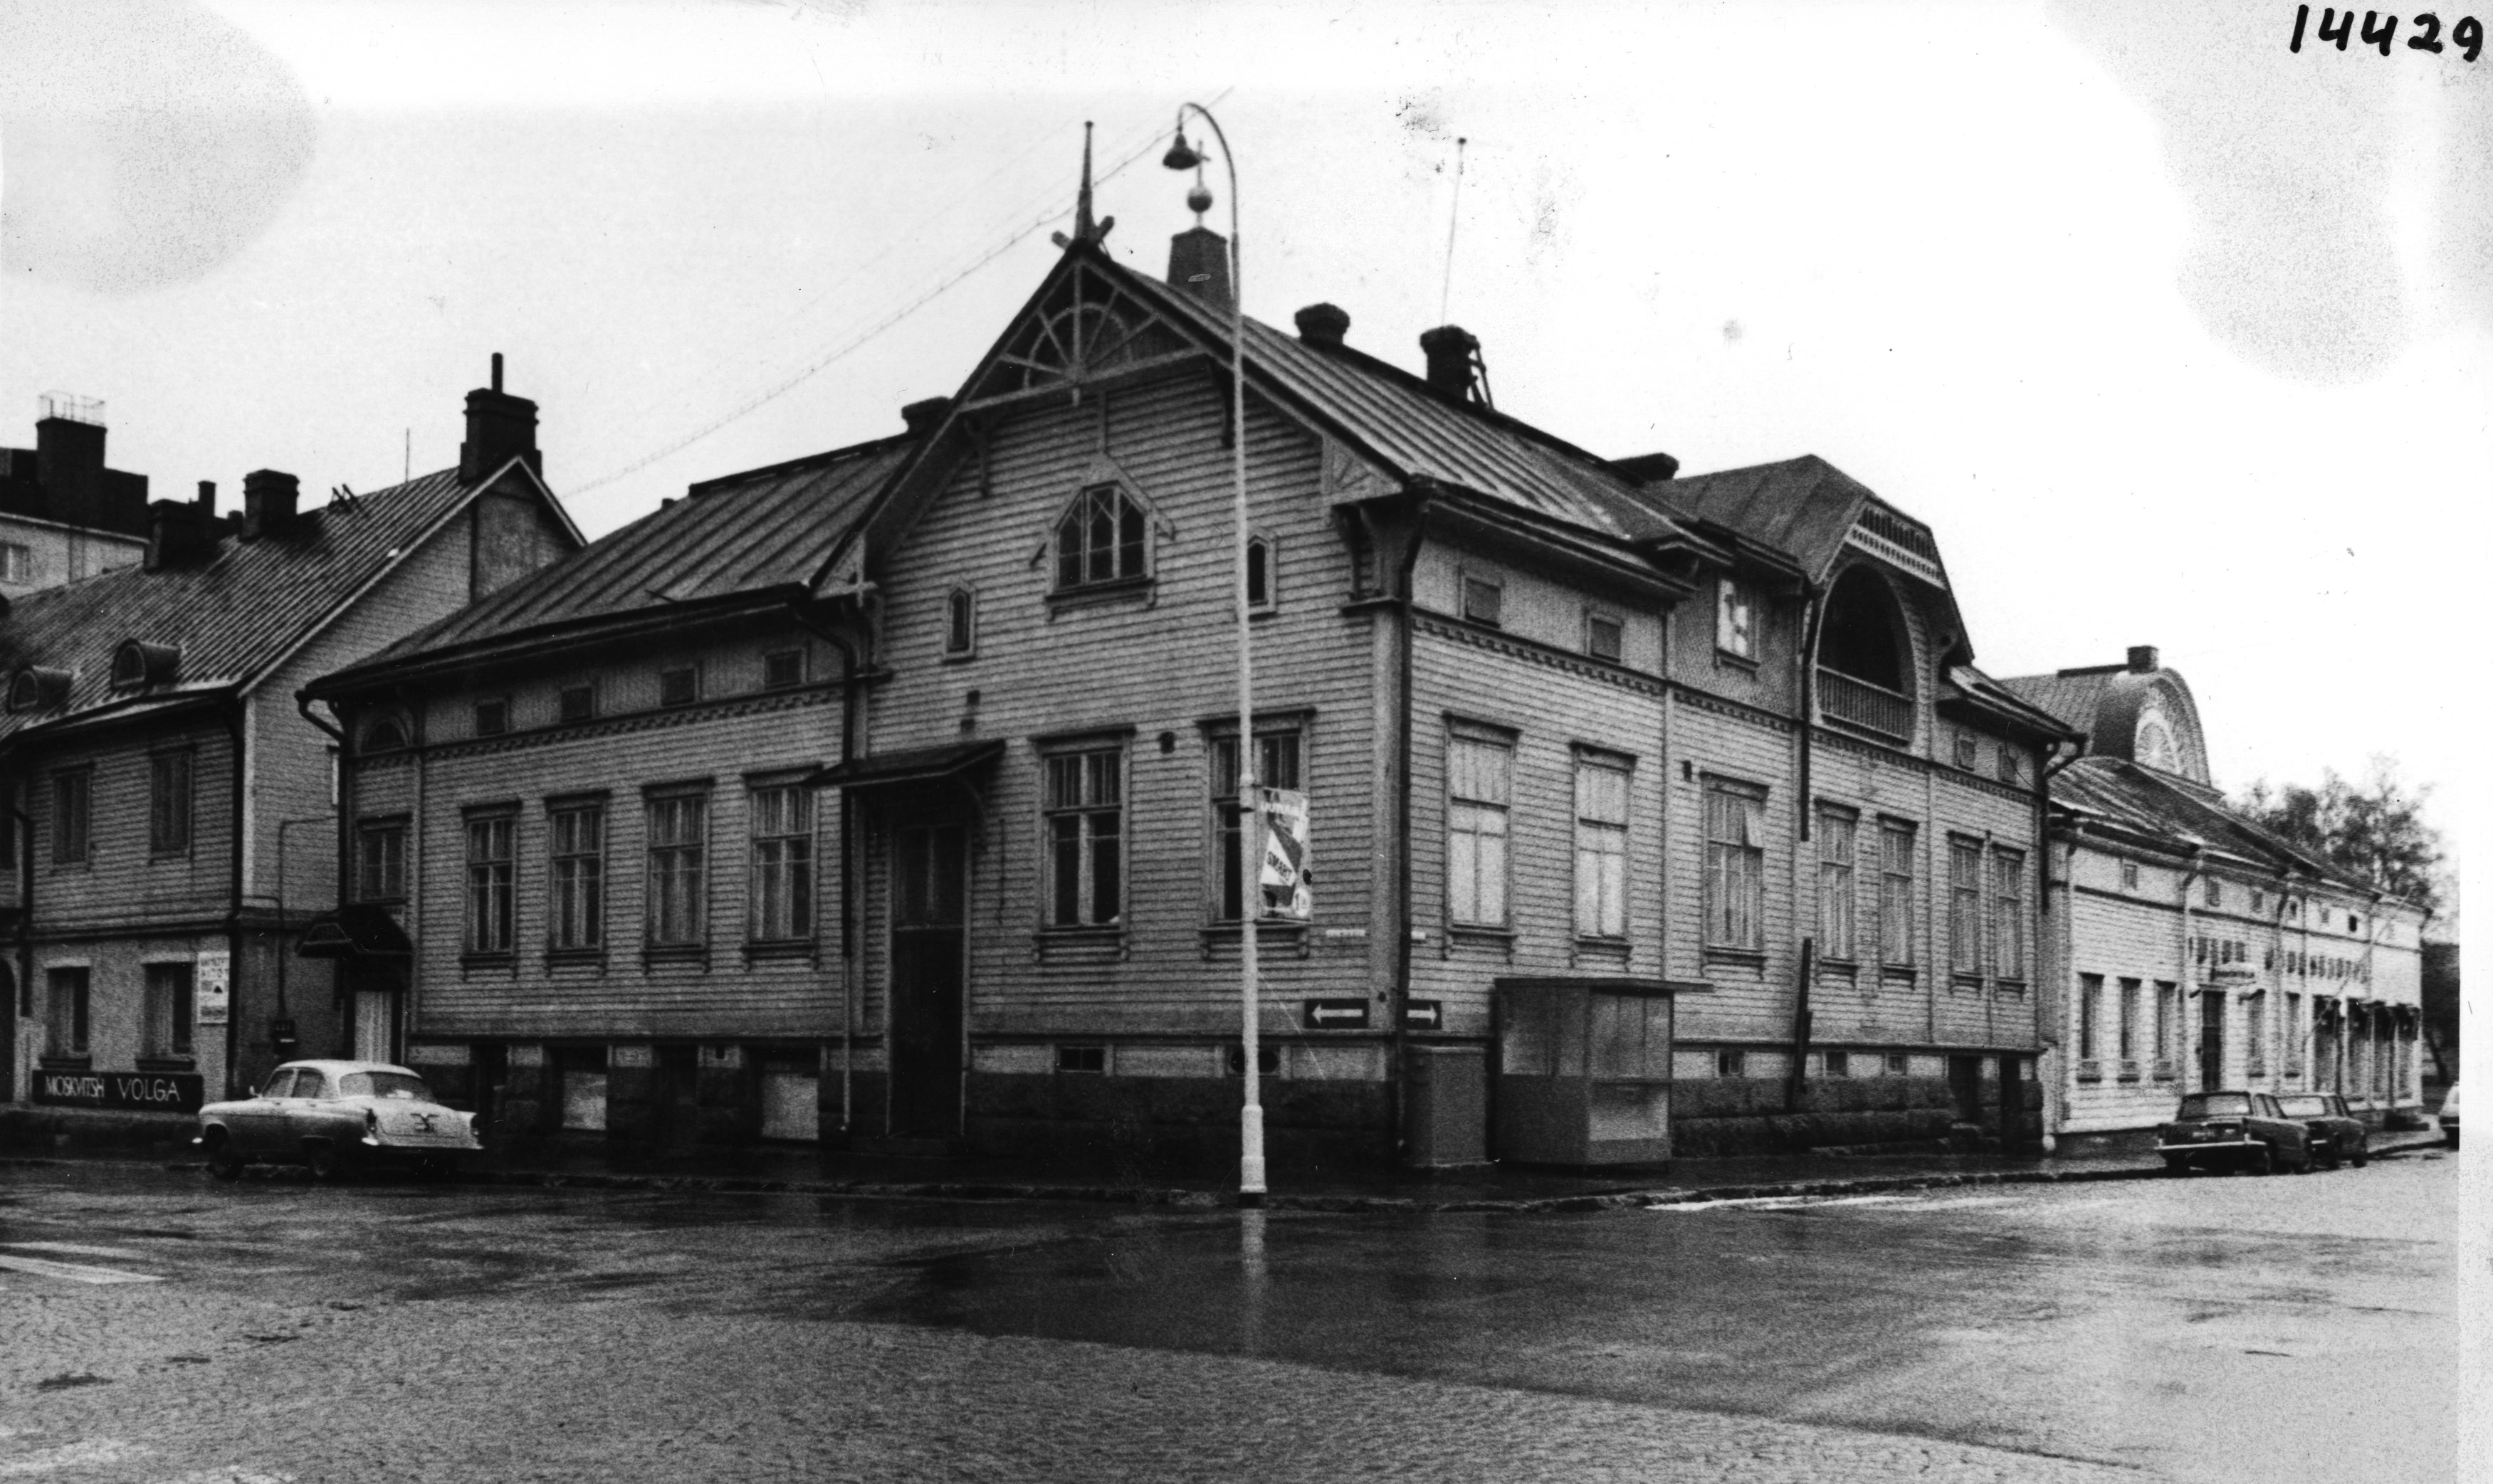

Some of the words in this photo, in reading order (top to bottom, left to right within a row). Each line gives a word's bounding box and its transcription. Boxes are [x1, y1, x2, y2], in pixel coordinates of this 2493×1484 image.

[2290, 4, 2483, 63] 14429
[45, 1075, 105, 1098] MOSKVITSH
[117, 1078, 181, 1102] VOLGA
